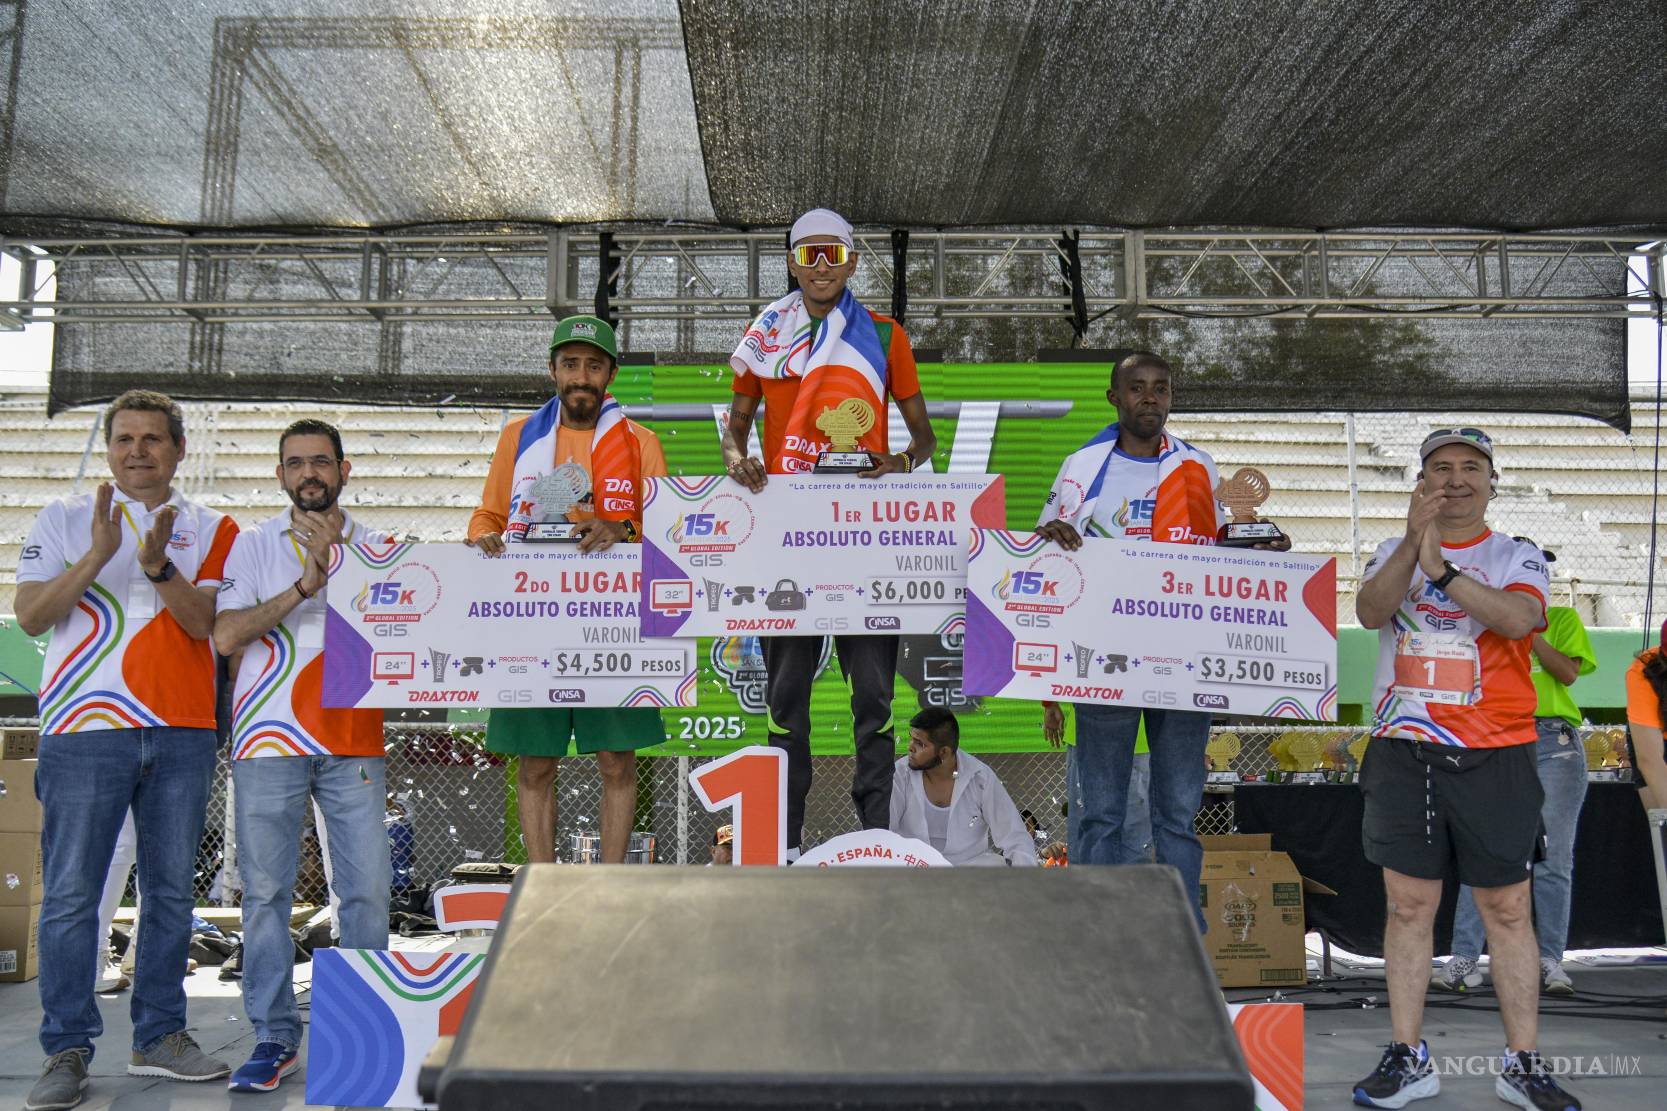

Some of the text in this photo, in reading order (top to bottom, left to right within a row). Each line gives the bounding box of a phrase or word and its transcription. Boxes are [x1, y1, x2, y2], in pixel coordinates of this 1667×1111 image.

[844, 482, 856, 490] de
[860, 483, 888, 491] mayor
[891, 482, 933, 490] tradición
[872, 501, 956, 522] LUGAR
[782, 530, 958, 547] ABSOLUTO GENERAL
[19, 545, 42, 560] IS
[690, 554, 722, 567] GIS
[1140, 552, 1174, 561] carrera
[1177, 552, 1189, 561] de
[1192, 555, 1221, 565] mayor
[1224, 556, 1265, 567] tradición
[896, 555, 958, 571] VARONIL
[560, 571, 642, 593] LUGAR
[1204, 574, 1288, 602] LUGAR
[826, 594, 844, 602] GIS
[872, 580, 945, 603] $6,000
[468, 602, 560, 618] ABSOLUTO
[1112, 598, 1288, 627] ABSOLUTO GENERAL
[726, 618, 796, 630] DRAXTON
[814, 618, 849, 630] GIS
[1016, 614, 1050, 628] GIS
[1425, 614, 1458, 630] GIS
[374, 624, 407, 637] GIS
[1226, 633, 1288, 653] VARONIL
[556, 652, 681, 676] $4,500 PESOS
[1142, 656, 1183, 665] PRODUCTOS
[508, 666, 528, 674] GIS
[1153, 666, 1172, 676] GIS
[1201, 657, 1322, 685] $3,500 PESOS
[1424, 660, 1436, 686] 1
[408, 690, 479, 702] DRAXTON
[498, 689, 533, 703] GIS
[928, 688, 967, 706] GIS
[1051, 684, 1123, 700] DRAXTON
[1142, 690, 1177, 705] GIS
[680, 716, 742, 739] 2025
[836, 844, 892, 863] ESPAÑA
